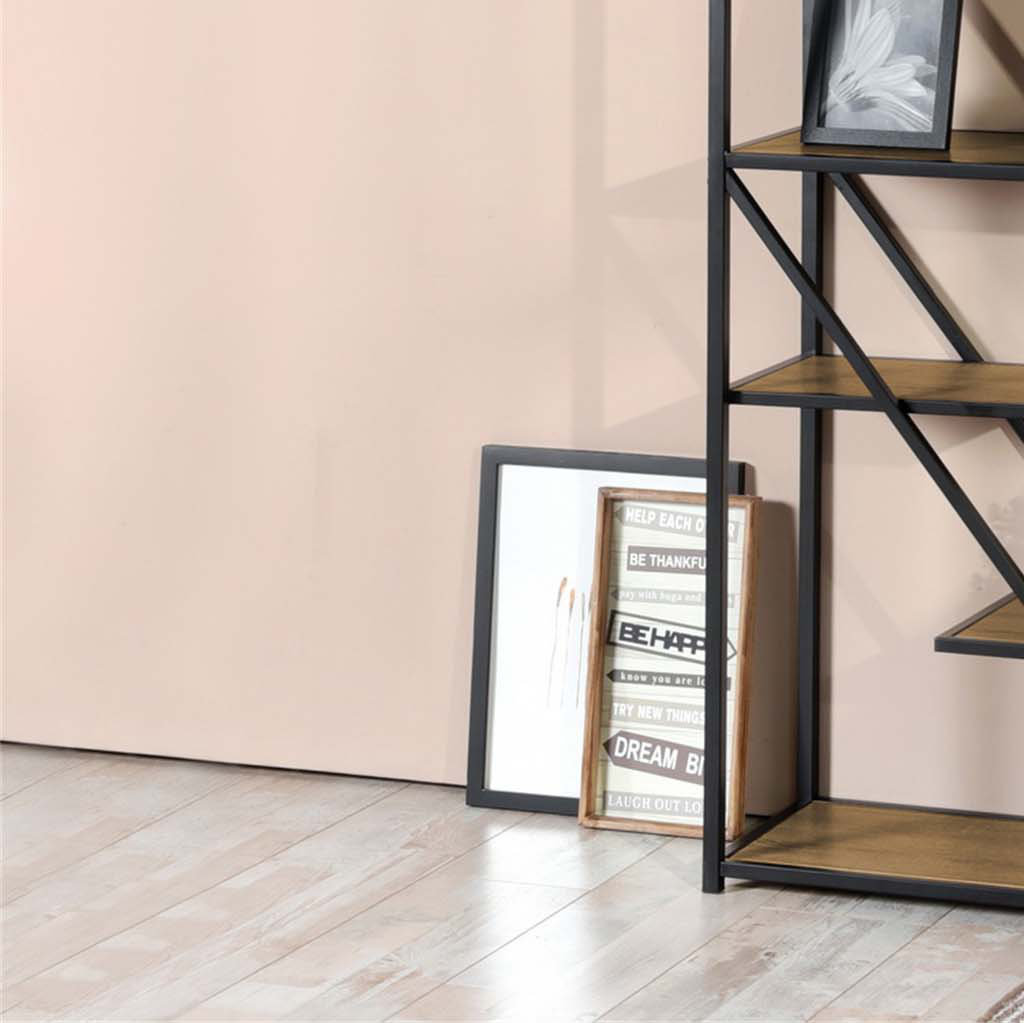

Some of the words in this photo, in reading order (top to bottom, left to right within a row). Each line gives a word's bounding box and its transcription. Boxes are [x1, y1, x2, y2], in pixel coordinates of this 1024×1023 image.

[624, 506, 656, 525] HELP
[659, 511, 692, 531] EACH
[629, 553, 647, 566] BE
[649, 554, 706, 570] THANKFU
[619, 622, 650, 645] BE
[650, 628, 706, 655] HAPP
[620, 672, 648, 682] know
[652, 674, 671, 686] you
[675, 676, 692, 685] are
[613, 703, 634, 717] TRY
[637, 704, 663, 720] NEW
[614, 736, 679, 770] DREAM
[685, 752, 705, 776] BI
[608, 795, 650, 810] LAUGH
[654, 798, 679, 812] OUT
[684, 800, 702, 814] LO
